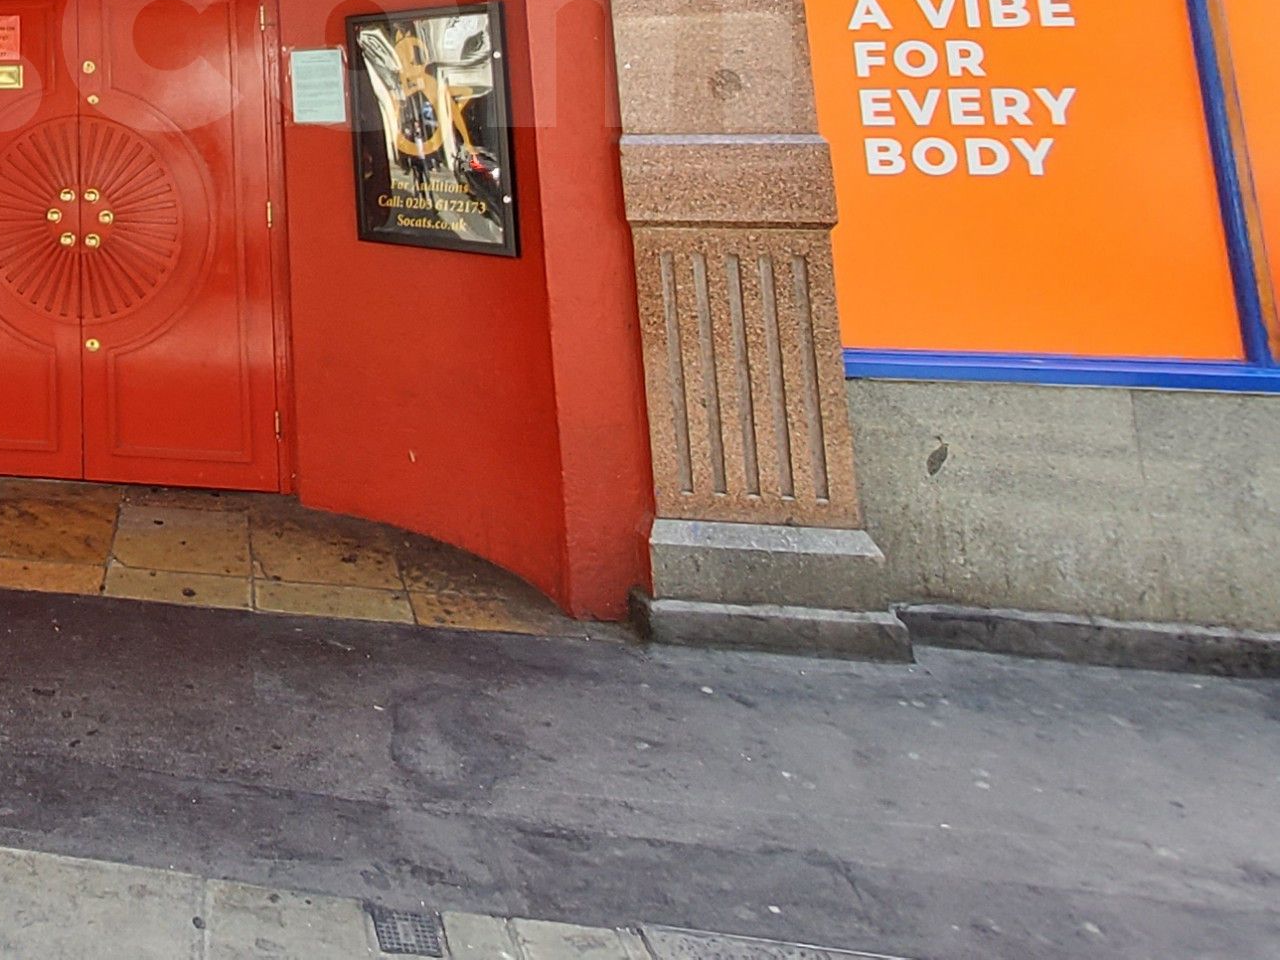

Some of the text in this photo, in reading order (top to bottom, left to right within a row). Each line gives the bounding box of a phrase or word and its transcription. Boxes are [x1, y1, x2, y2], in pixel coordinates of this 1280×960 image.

[853, 40, 987, 78] FOR
[859, 88, 1076, 126] EVERY
[864, 137, 1054, 176] BODY
[378, 194, 404, 208] Call:
